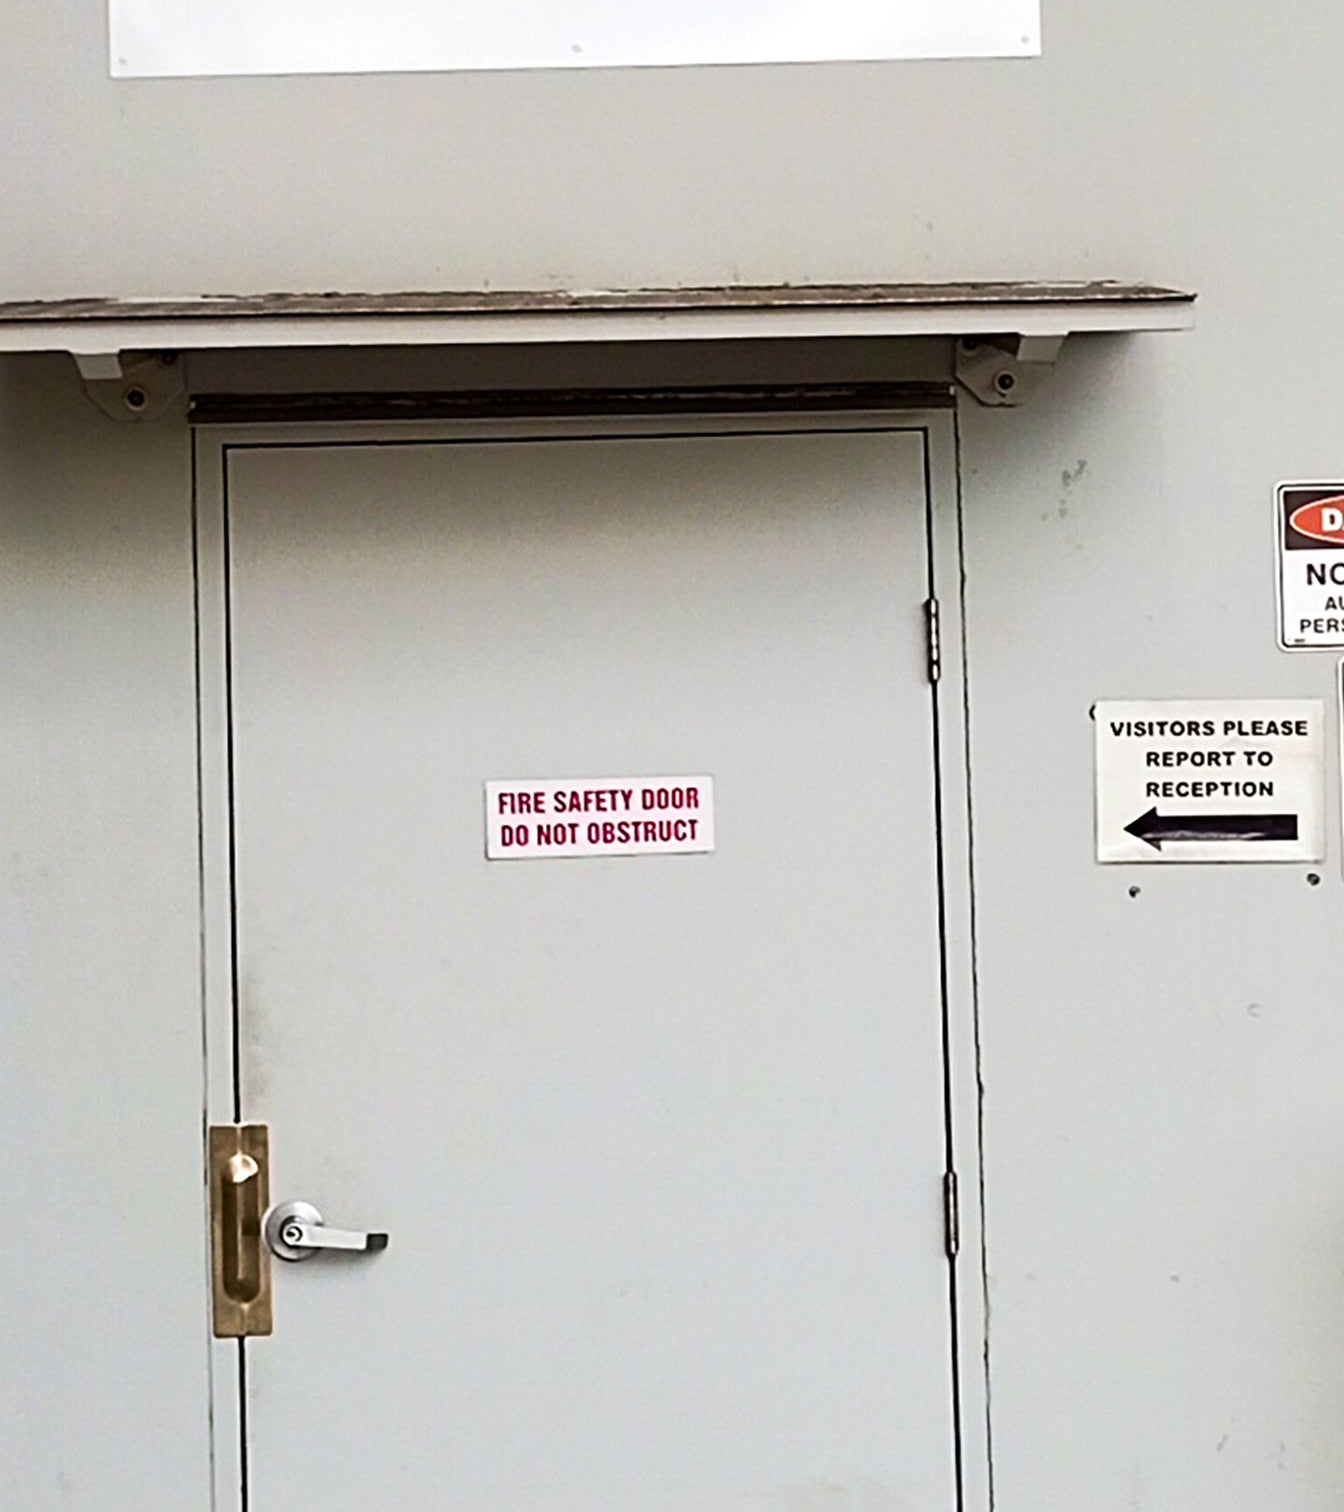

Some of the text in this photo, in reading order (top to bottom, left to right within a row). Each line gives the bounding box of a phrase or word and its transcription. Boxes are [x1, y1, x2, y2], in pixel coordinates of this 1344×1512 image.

[1110, 719, 1308, 738] VISITORS PLEASE
[1146, 750, 1274, 768] REPORT TO
[1146, 781, 1274, 798] RECEPTION
[497, 787, 700, 815] FIRE SAFETY DOOR
[500, 818, 699, 848] DO NOT OBSTRUCT
